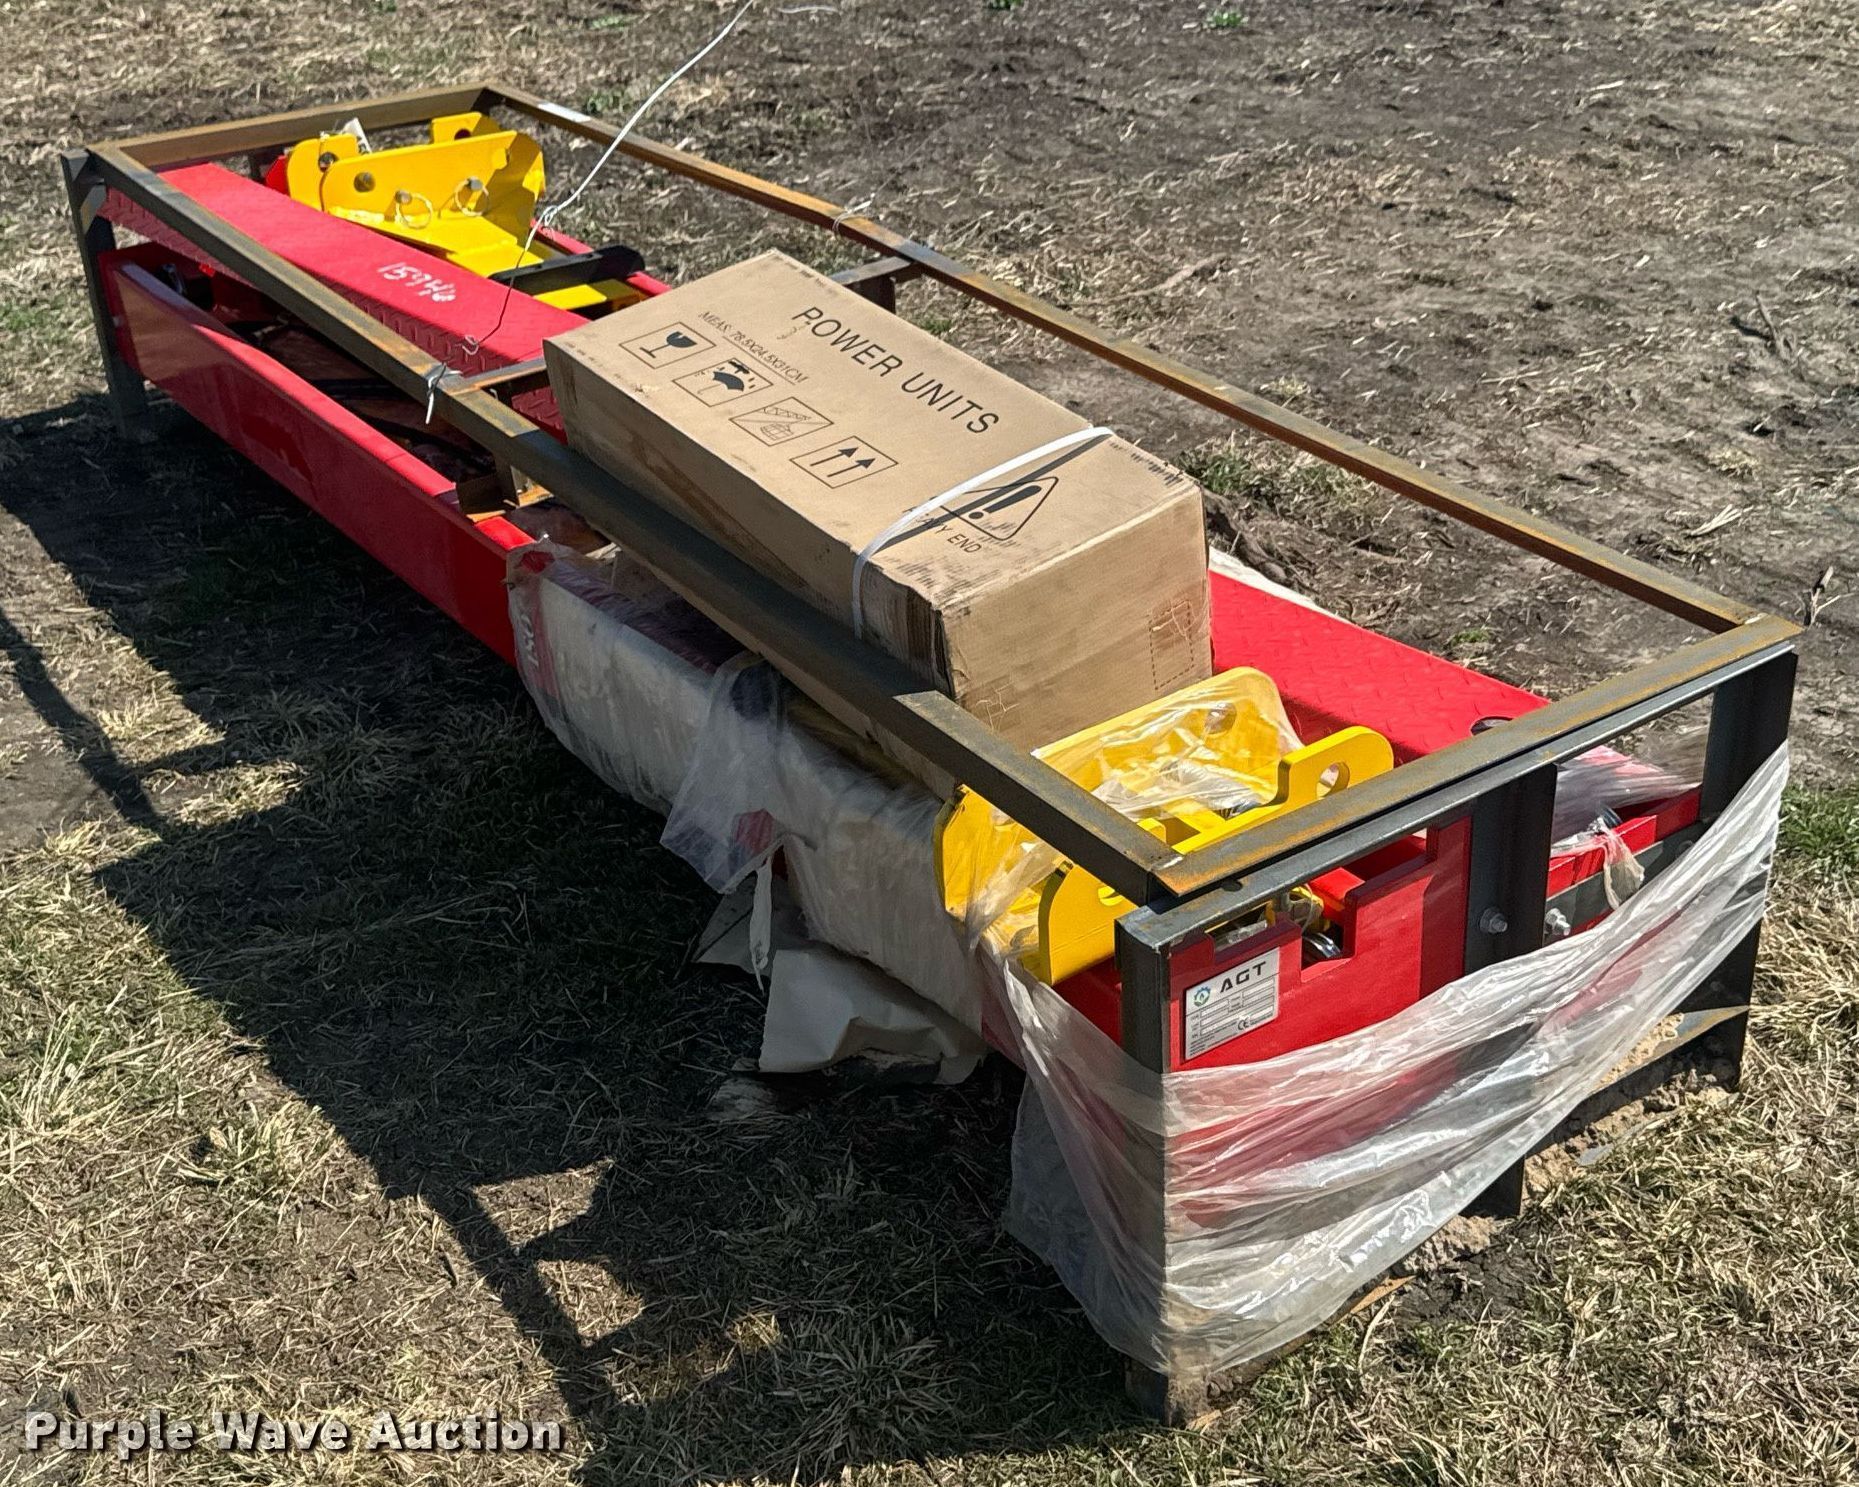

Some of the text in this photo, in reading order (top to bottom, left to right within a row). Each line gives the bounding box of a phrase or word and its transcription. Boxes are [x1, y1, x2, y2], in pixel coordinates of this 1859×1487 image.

[791, 306, 1000, 434] POWER UNITS
[946, 533, 983, 554] END
[1219, 961, 1267, 993] AGT
